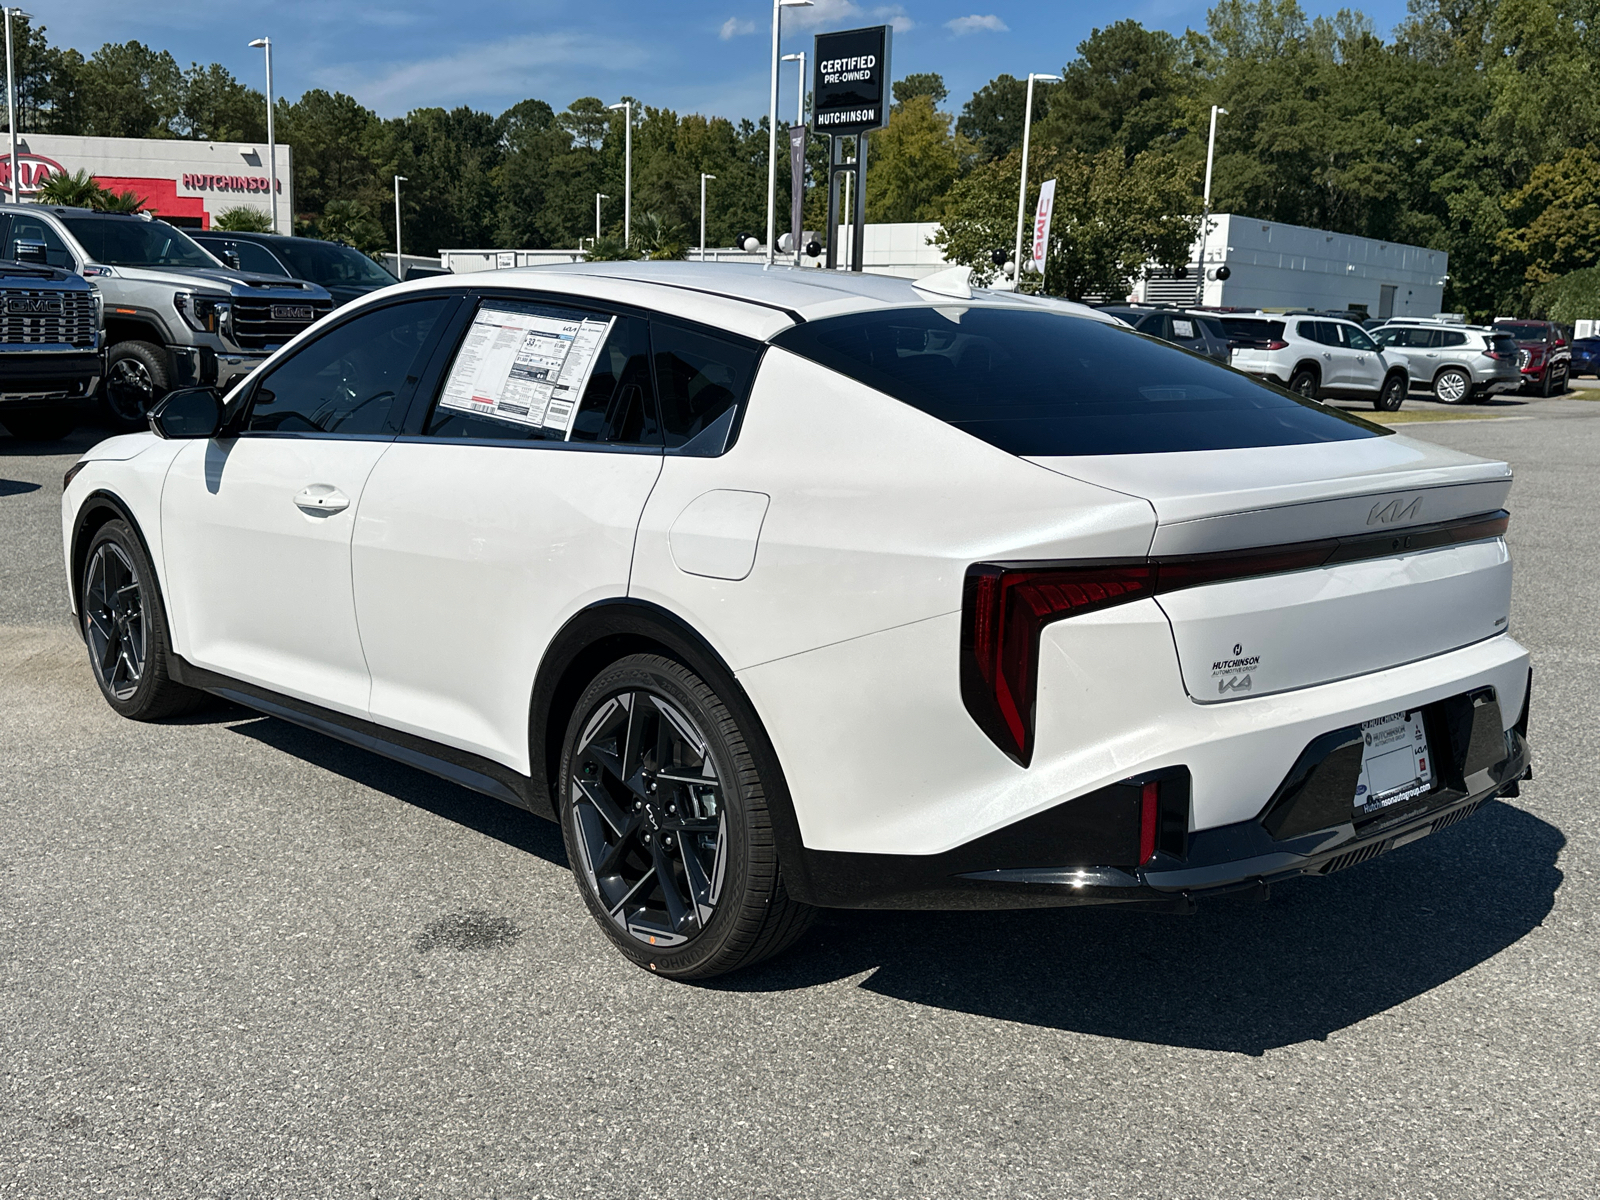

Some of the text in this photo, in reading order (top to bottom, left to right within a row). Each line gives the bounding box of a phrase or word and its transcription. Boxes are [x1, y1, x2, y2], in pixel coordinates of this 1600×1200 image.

[820, 55, 876, 73] CERTIFIED
[824, 70, 871, 84] PRE-OWNED
[818, 109, 875, 125] HUTCHINSON
[9, 299, 62, 312] GMC
[274, 306, 312, 318] GMC
[1366, 496, 1424, 526] KIA
[1212, 656, 1260, 670] HUTCHINSON
[1212, 668, 1242, 676] AUTOMOTIVE
[660, 943, 710, 969] KUMHO
